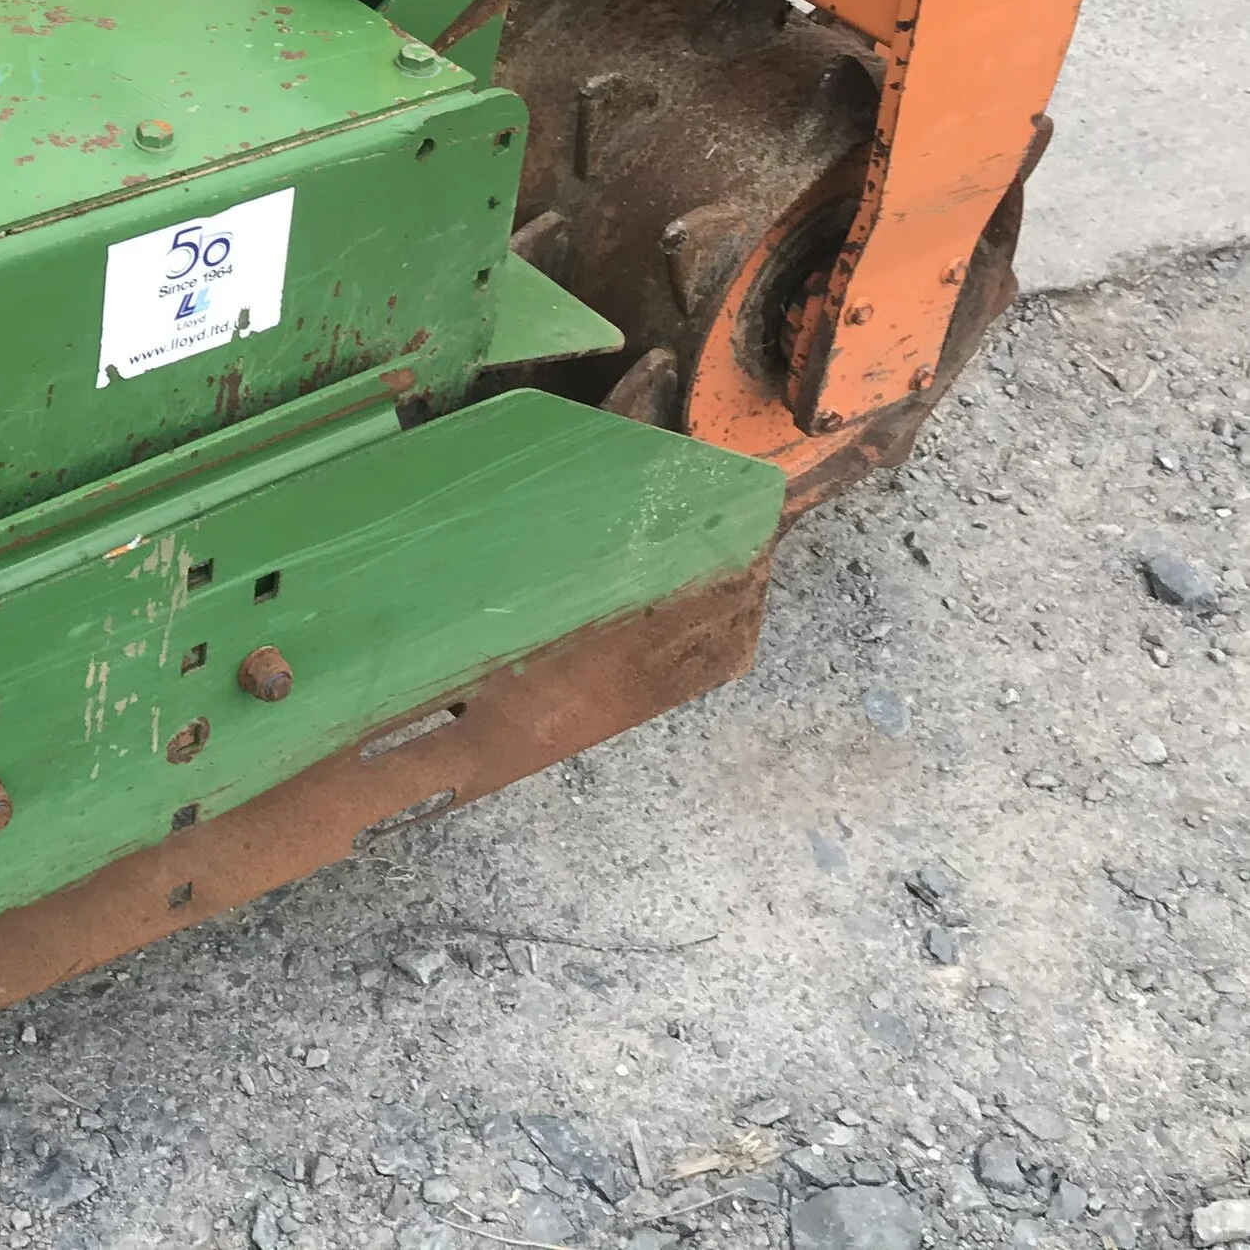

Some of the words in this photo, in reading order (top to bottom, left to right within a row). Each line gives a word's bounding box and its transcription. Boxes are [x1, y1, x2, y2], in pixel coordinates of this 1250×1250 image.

[165, 226, 231, 280] 50
[158, 278, 197, 298] Since
[203, 264, 233, 283] 1964
[176, 314, 206, 331] Lloyd
